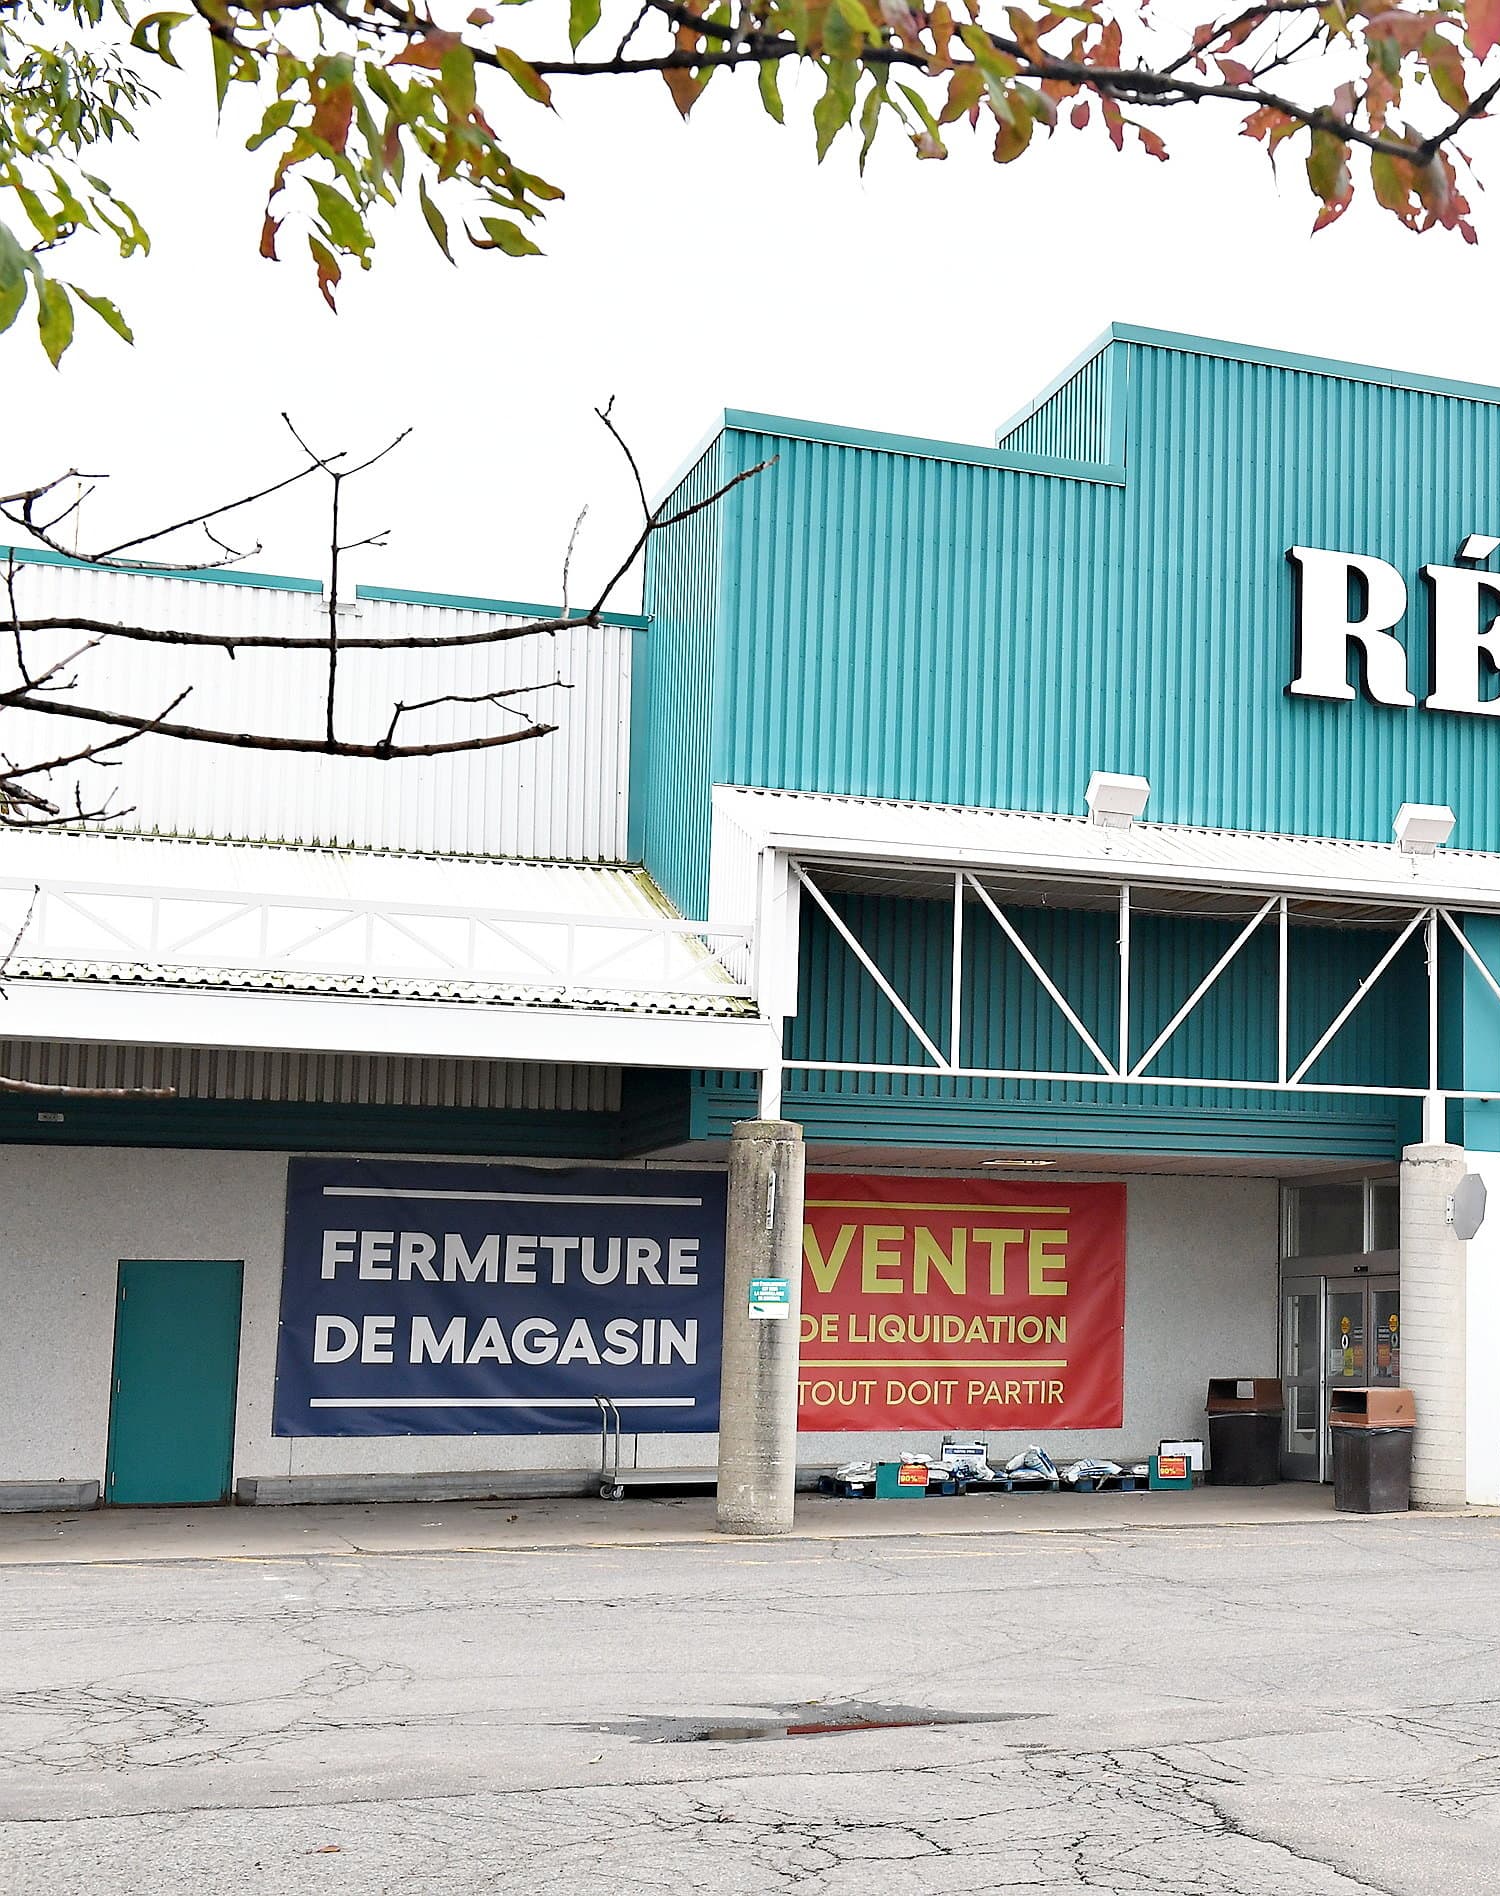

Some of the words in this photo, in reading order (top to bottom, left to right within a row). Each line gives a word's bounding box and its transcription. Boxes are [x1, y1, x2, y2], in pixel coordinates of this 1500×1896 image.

[320, 1229, 700, 1286] FERMETURE
[803, 1223, 1069, 1296] VENTE
[313, 1314, 396, 1364] DE
[409, 1315, 698, 1366] MAGASIN
[800, 1314, 840, 1343] DE
[849, 1313, 1067, 1345] LIQUIDATION
[798, 1380, 878, 1407] TOUT
[886, 1379, 959, 1406] DOIT
[967, 1379, 1065, 1406] PARTIR
